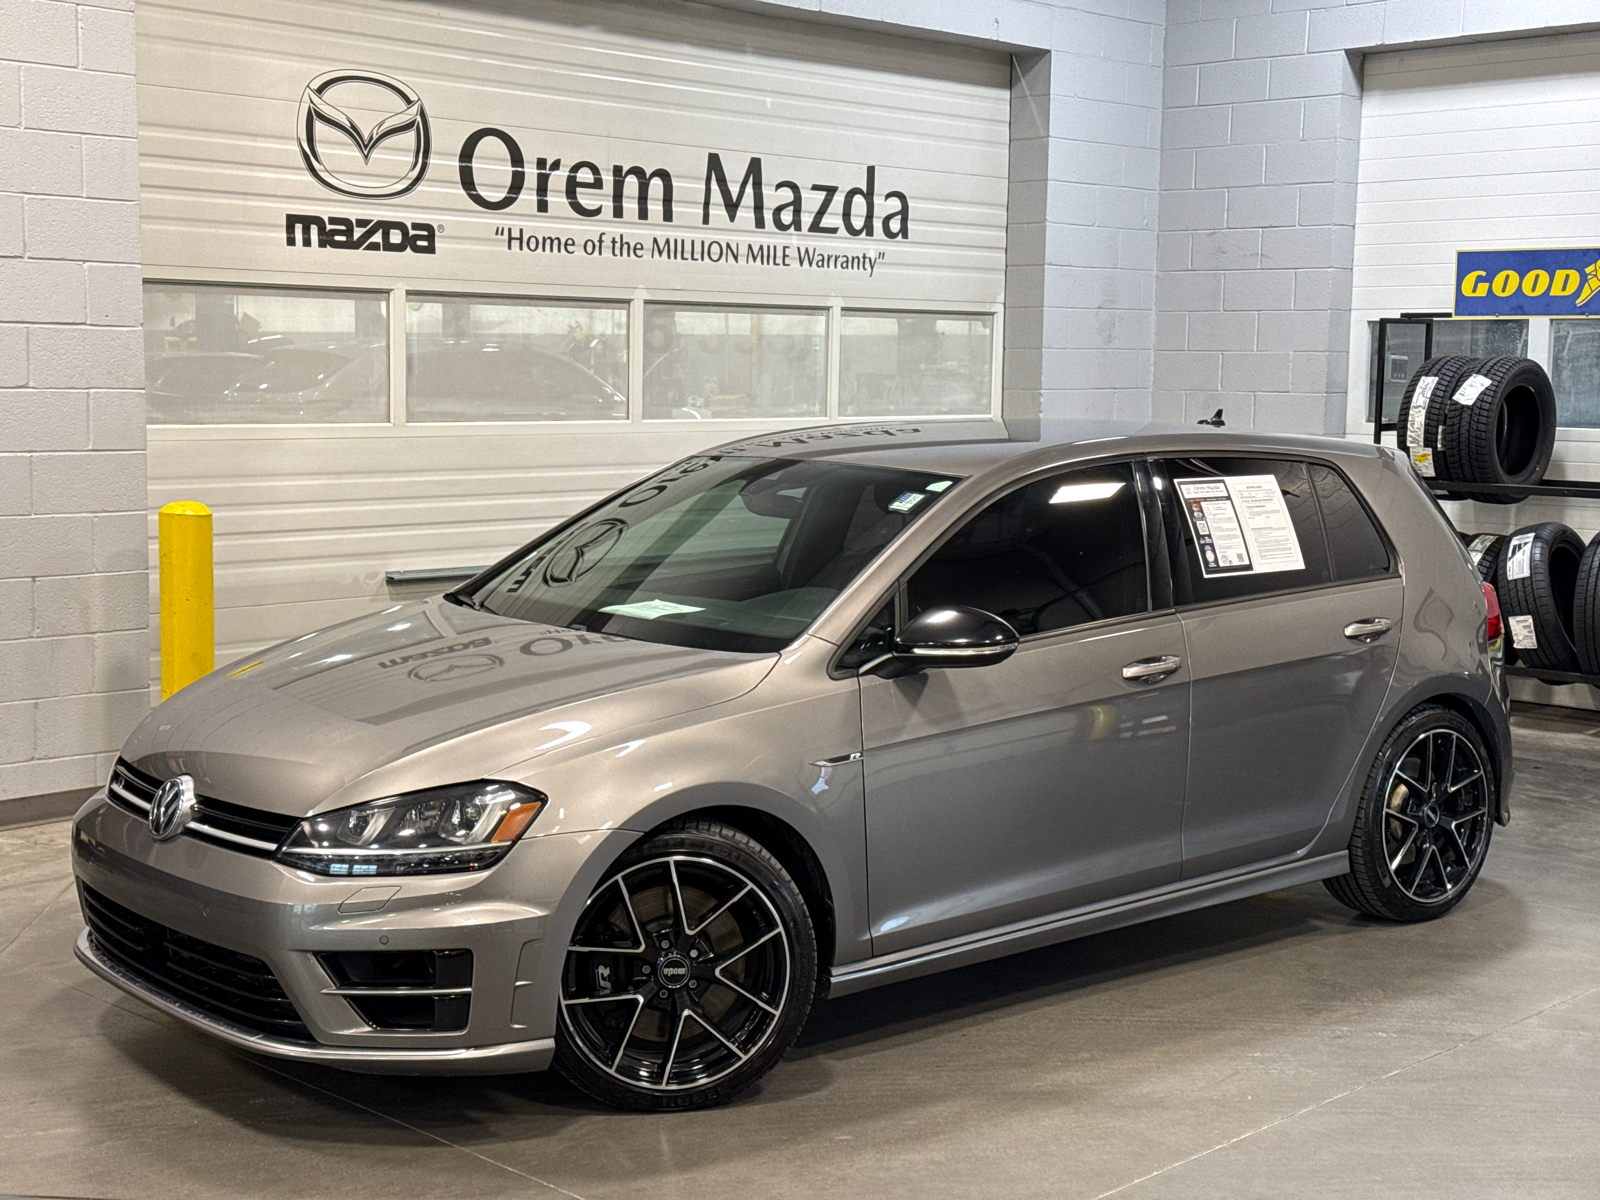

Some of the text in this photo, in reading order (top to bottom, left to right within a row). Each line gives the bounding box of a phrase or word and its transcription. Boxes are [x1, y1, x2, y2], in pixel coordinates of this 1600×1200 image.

[458, 127, 911, 241] Orem Mazda
[583, 232, 606, 256] of
[610, 234, 645, 258] the
[651, 237, 739, 264] MILLION
[746, 243, 791, 267] MILE
[1461, 269, 1581, 297] GOOD
